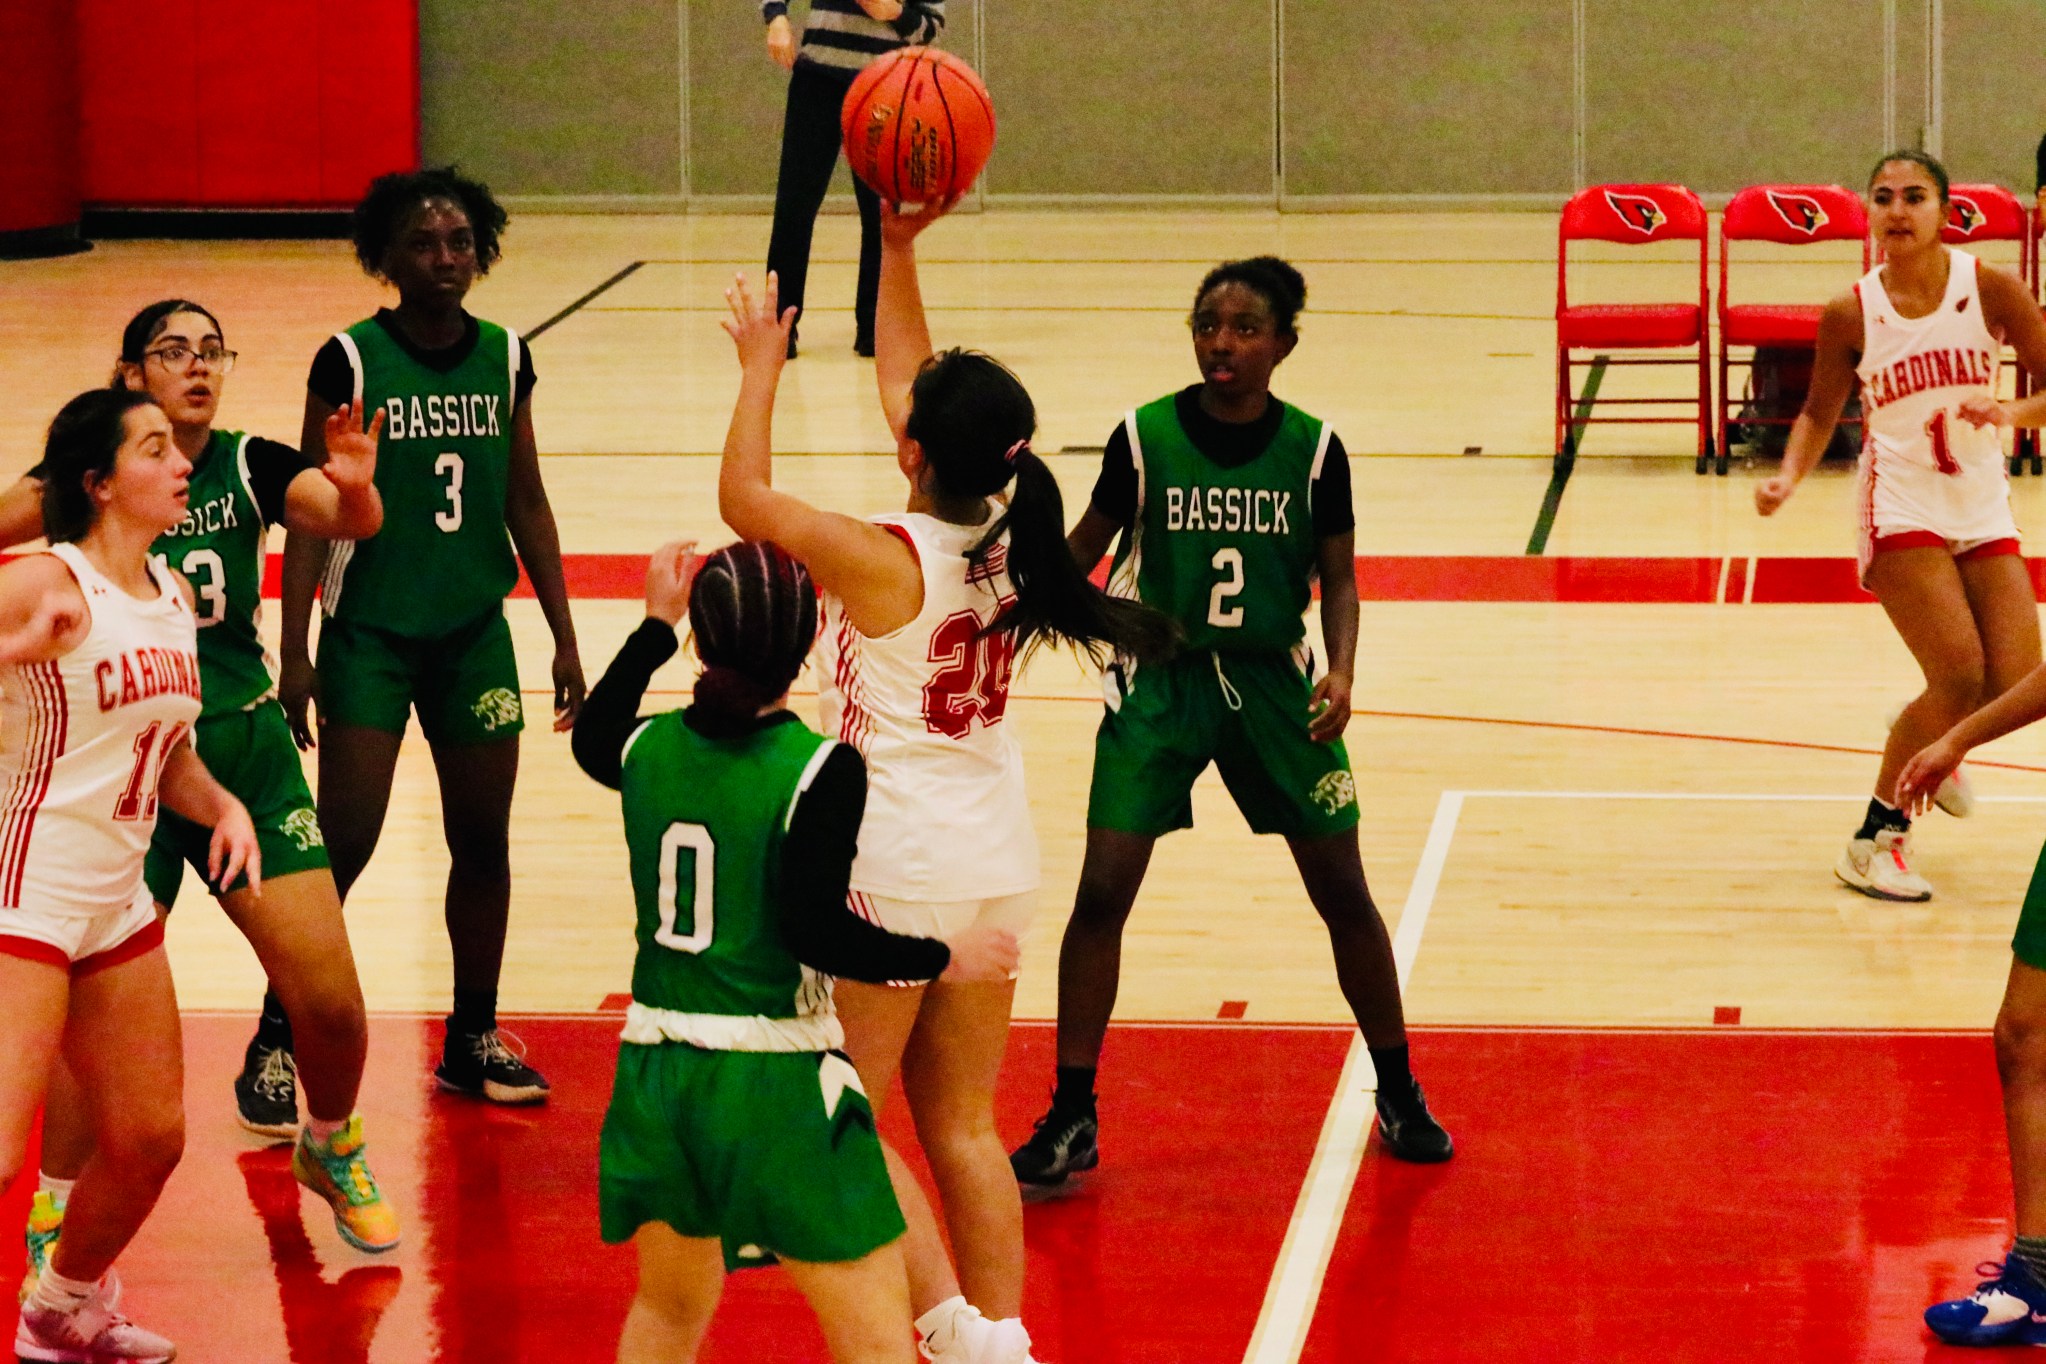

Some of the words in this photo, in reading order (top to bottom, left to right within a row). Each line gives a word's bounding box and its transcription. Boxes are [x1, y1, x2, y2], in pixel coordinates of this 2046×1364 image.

[1871, 348, 1991, 409] CARDINALS
[386, 394, 500, 440] BASSICK
[1924, 407, 1963, 477] 1
[434, 452, 464, 533] 3
[1166, 486, 1291, 535] BASSICK
[156, 548, 227, 630] 3
[1207, 547, 1245, 628] 2
[653, 820, 716, 956] 0
